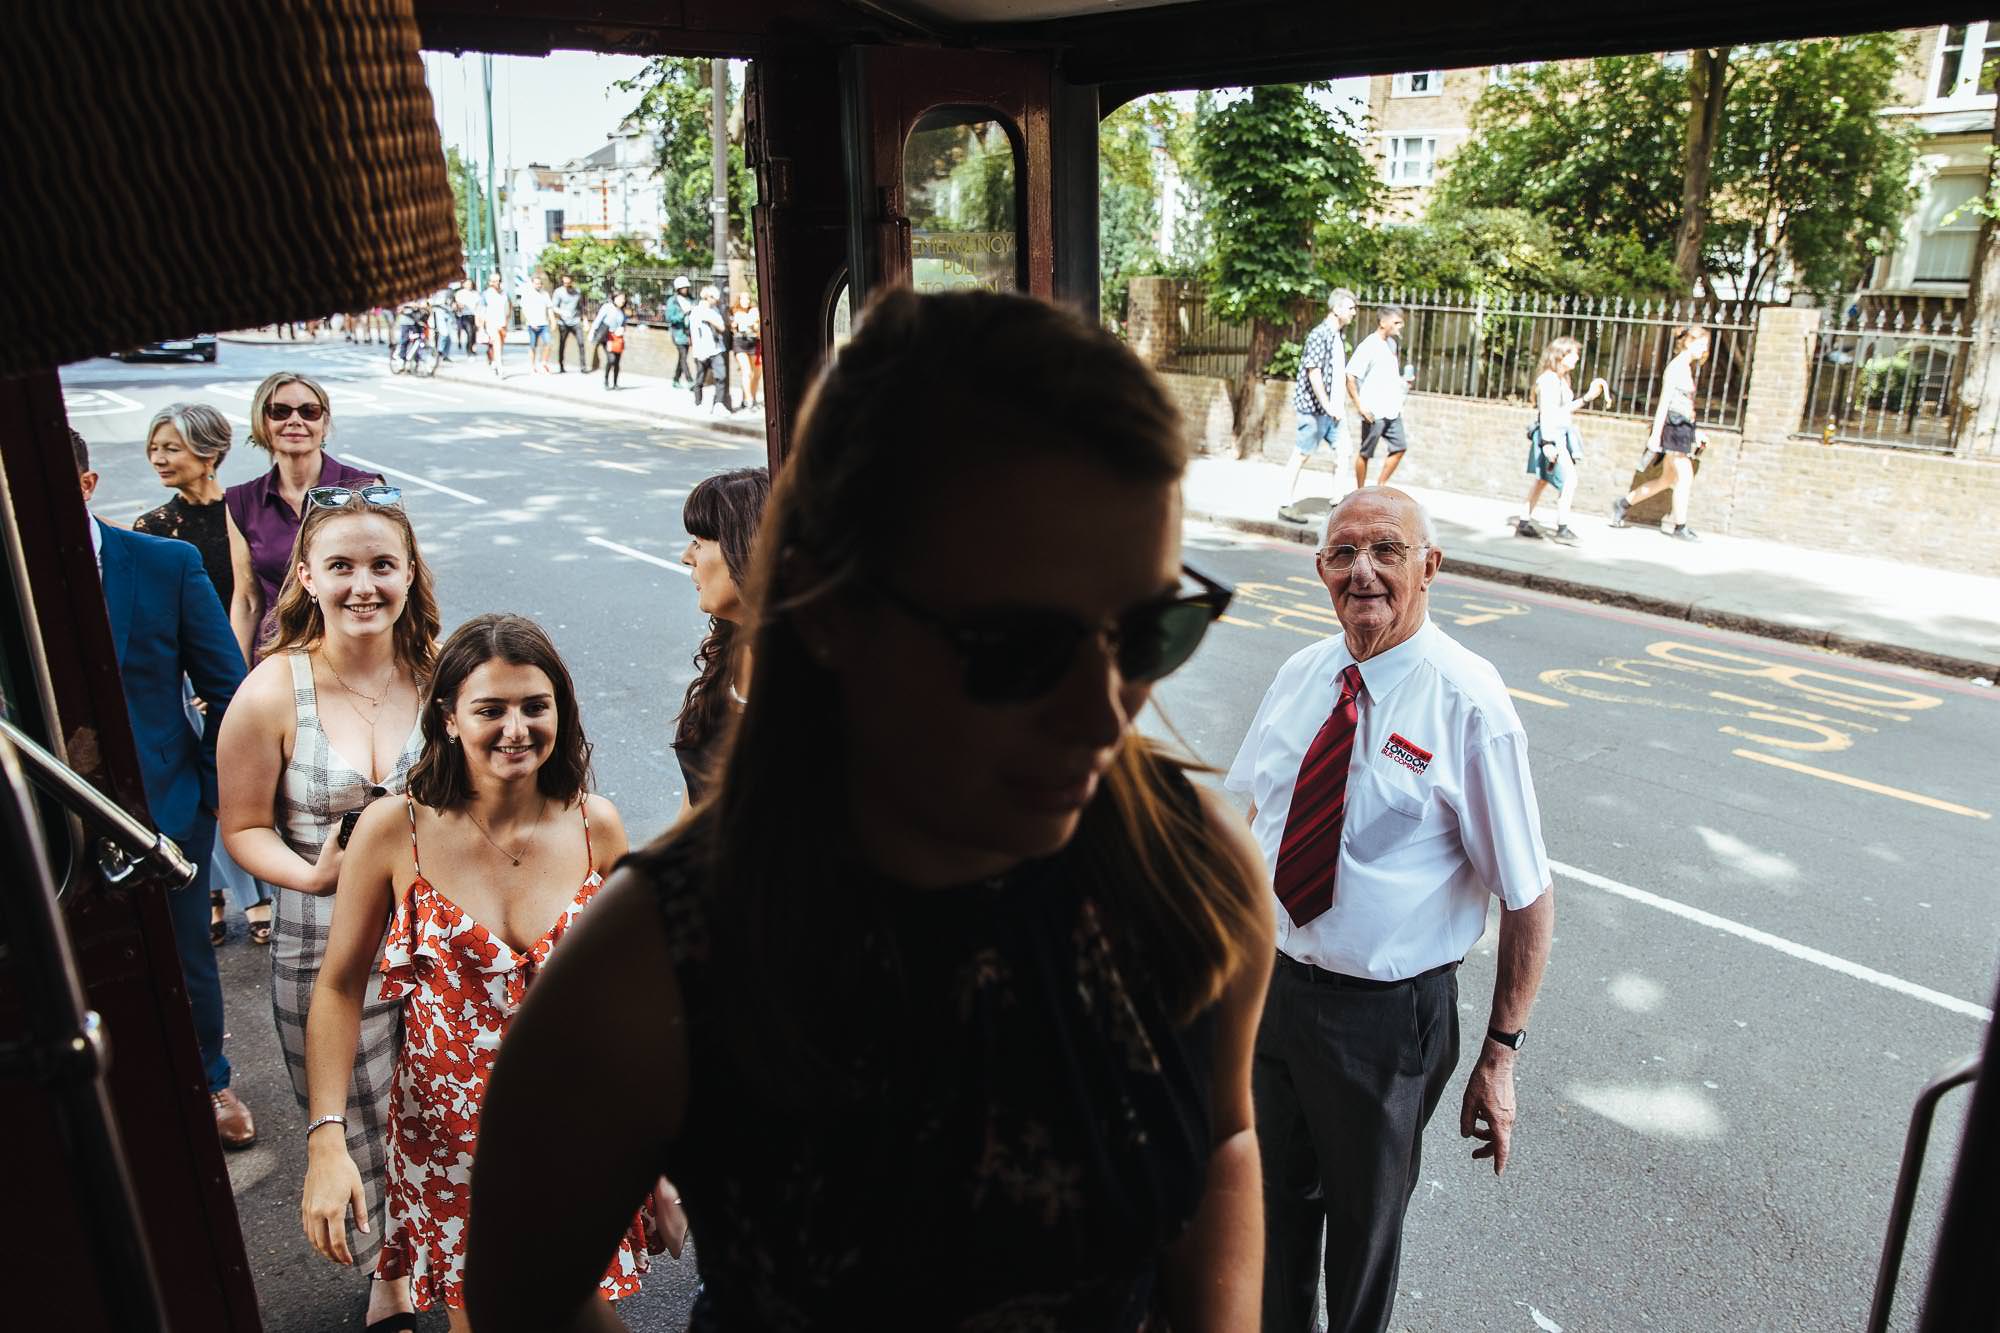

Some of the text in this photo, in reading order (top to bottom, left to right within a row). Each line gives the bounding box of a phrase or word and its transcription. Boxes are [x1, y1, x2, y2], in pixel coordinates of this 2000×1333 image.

[943, 258, 983, 276] PULL
[1381, 748, 1424, 775] BUS COMPANY
[1385, 742, 1428, 770] LONDON
